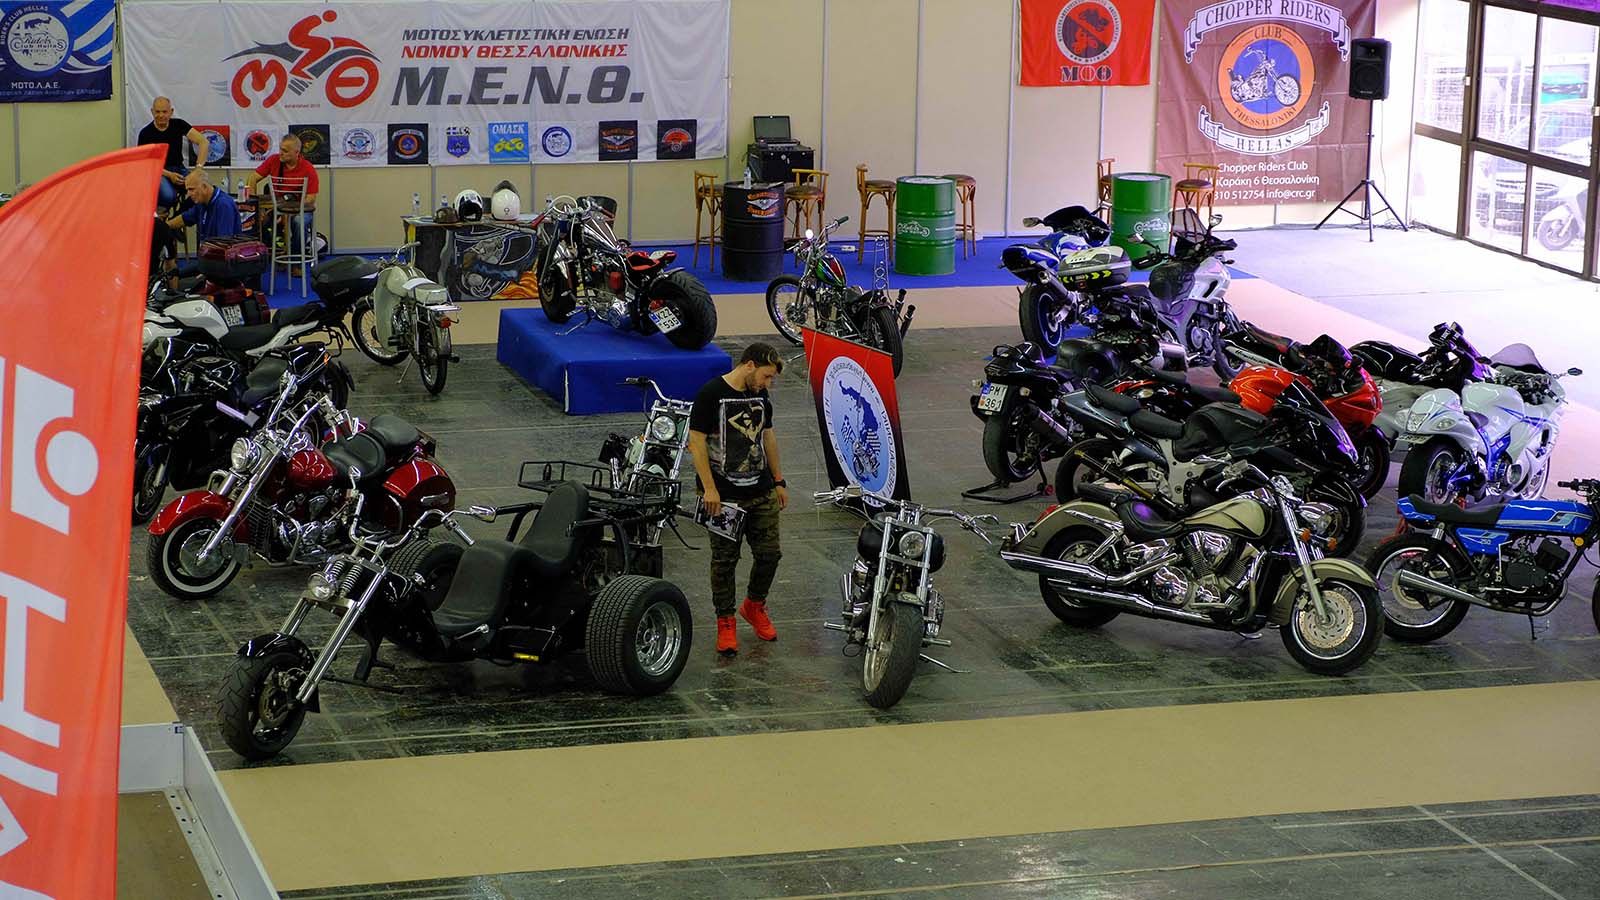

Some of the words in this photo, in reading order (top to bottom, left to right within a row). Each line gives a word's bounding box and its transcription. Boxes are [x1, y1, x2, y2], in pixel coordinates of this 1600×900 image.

[1205, 0, 1273, 26] CHOPPER
[1280, 0, 1331, 26] RIDERS
[402, 29, 570, 41] ΜΟΤΟΣΥΚΛΕΤΙΣΤΙΚΗ
[573, 28, 629, 40] ΕΝΩΣΗ
[1253, 26, 1283, 39] CLUB
[401, 45, 473, 58] ΝΟΜΟΥ
[477, 44, 628, 58] ΘΕΣΣΑΛΟΝΙΚΗΣ
[391, 65, 645, 106] Μ.Ε.Ν.Θ.
[1233, 106, 1298, 127] THESSALONIKI
[1236, 135, 1292, 152] HELLAS
[1218, 162, 1257, 174] Chopper
[1259, 161, 1286, 171] Riders
[1287, 160, 1309, 171] Club
[1254, 176, 1260, 185] 6
[1261, 174, 1320, 185] Θεσσαλονίκη
[1231, 190, 1265, 200] 512754
[1266, 189, 1316, 200] info@crc.gr
